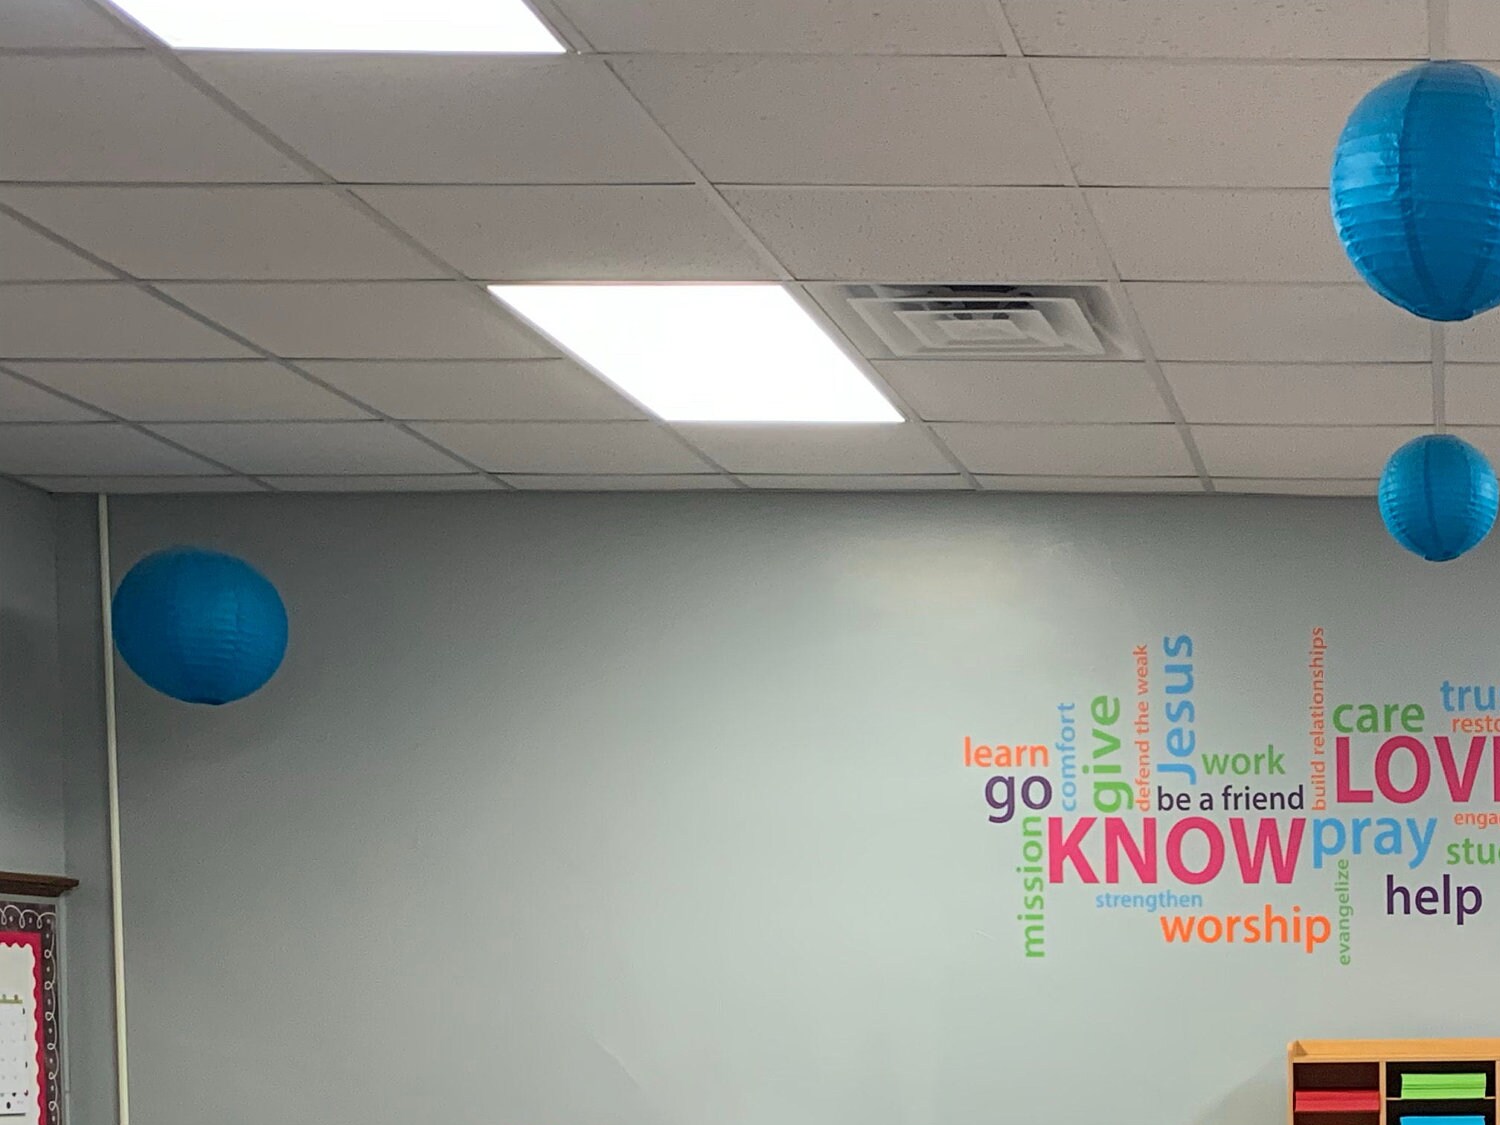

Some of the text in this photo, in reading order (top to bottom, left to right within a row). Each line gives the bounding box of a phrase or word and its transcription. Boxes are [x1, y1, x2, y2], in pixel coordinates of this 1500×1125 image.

[1133, 644, 1151, 812] defend the weak
[1157, 633, 1196, 784] Jesus
[1309, 626, 1328, 810] build relationships
[1332, 704, 1424, 733] care
[964, 736, 1048, 767] learn
[1057, 702, 1076, 812] comfort
[1082, 695, 1134, 813] give
[1202, 744, 1285, 775] work
[985, 775, 1052, 823] go
[1158, 785, 1303, 811] be a friend
[1048, 816, 1306, 885] KNOW
[1312, 817, 1437, 869] pray
[1016, 816, 1045, 957] mission
[1096, 889, 1203, 912] strengthen
[1335, 859, 1353, 965] evangelize
[1387, 874, 1482, 925] help
[1160, 904, 1331, 953] worship
